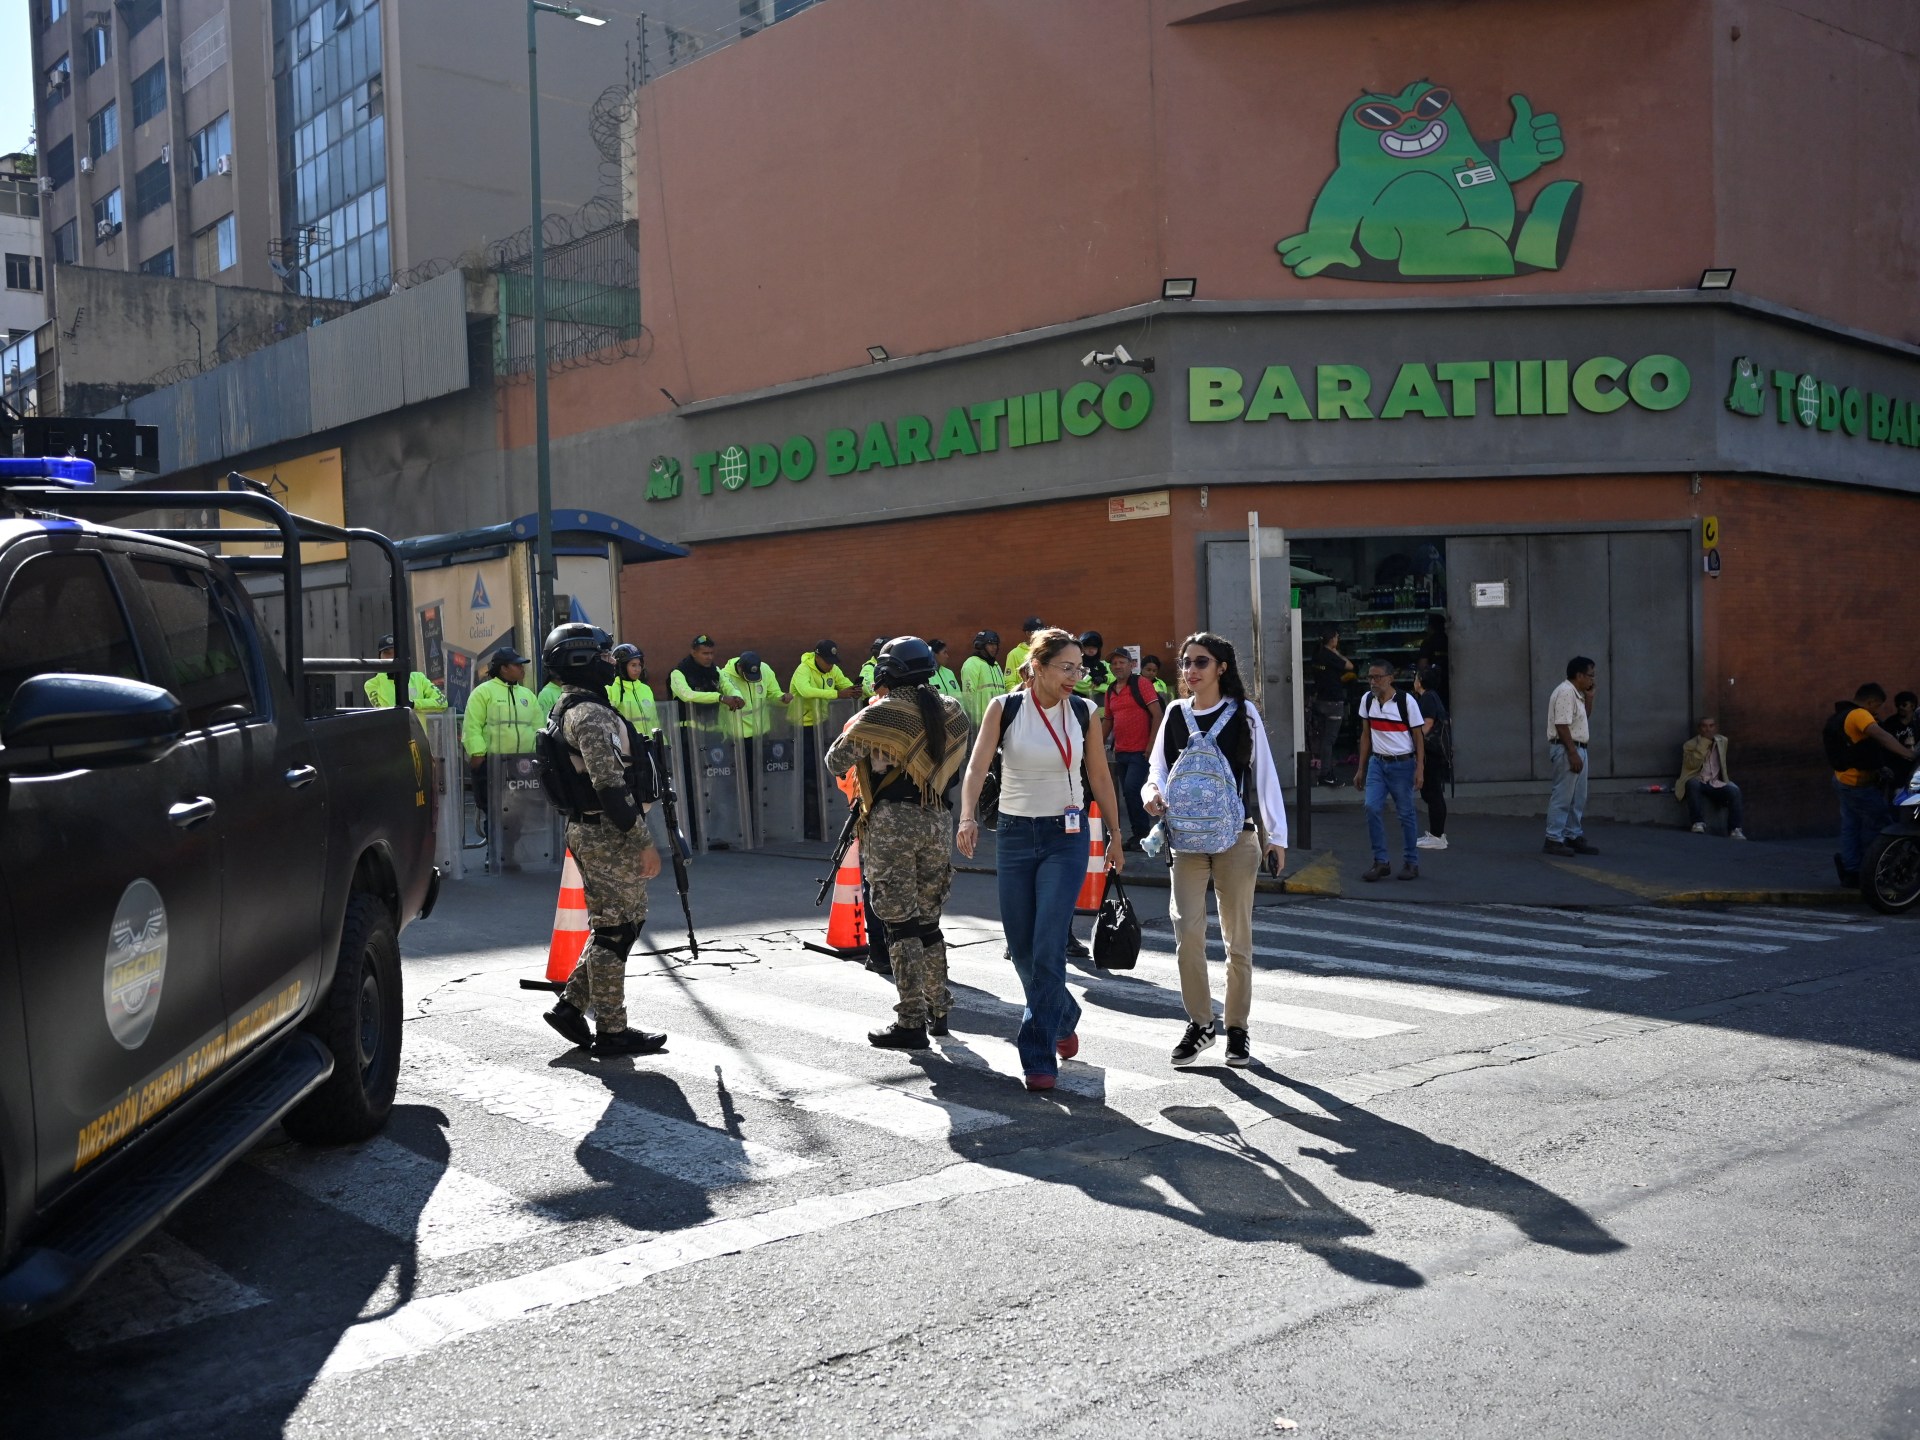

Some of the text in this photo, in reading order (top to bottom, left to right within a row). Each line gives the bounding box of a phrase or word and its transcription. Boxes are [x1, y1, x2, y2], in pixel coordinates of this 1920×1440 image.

[1188, 354, 1692, 422] BARATIIICO
[1771, 369, 1864, 437] TODO
[693, 373, 1155, 495] TODO BARATIIICO
[475, 611, 485, 625] Sal
[469, 624, 493, 639] Celestial
[706, 767, 731, 777] CPNB
[766, 762, 789, 772] CPNB
[508, 780, 540, 790] CPNB
[138, 1062, 184, 1125] GENERAL
[183, 1051, 199, 1093] DE
